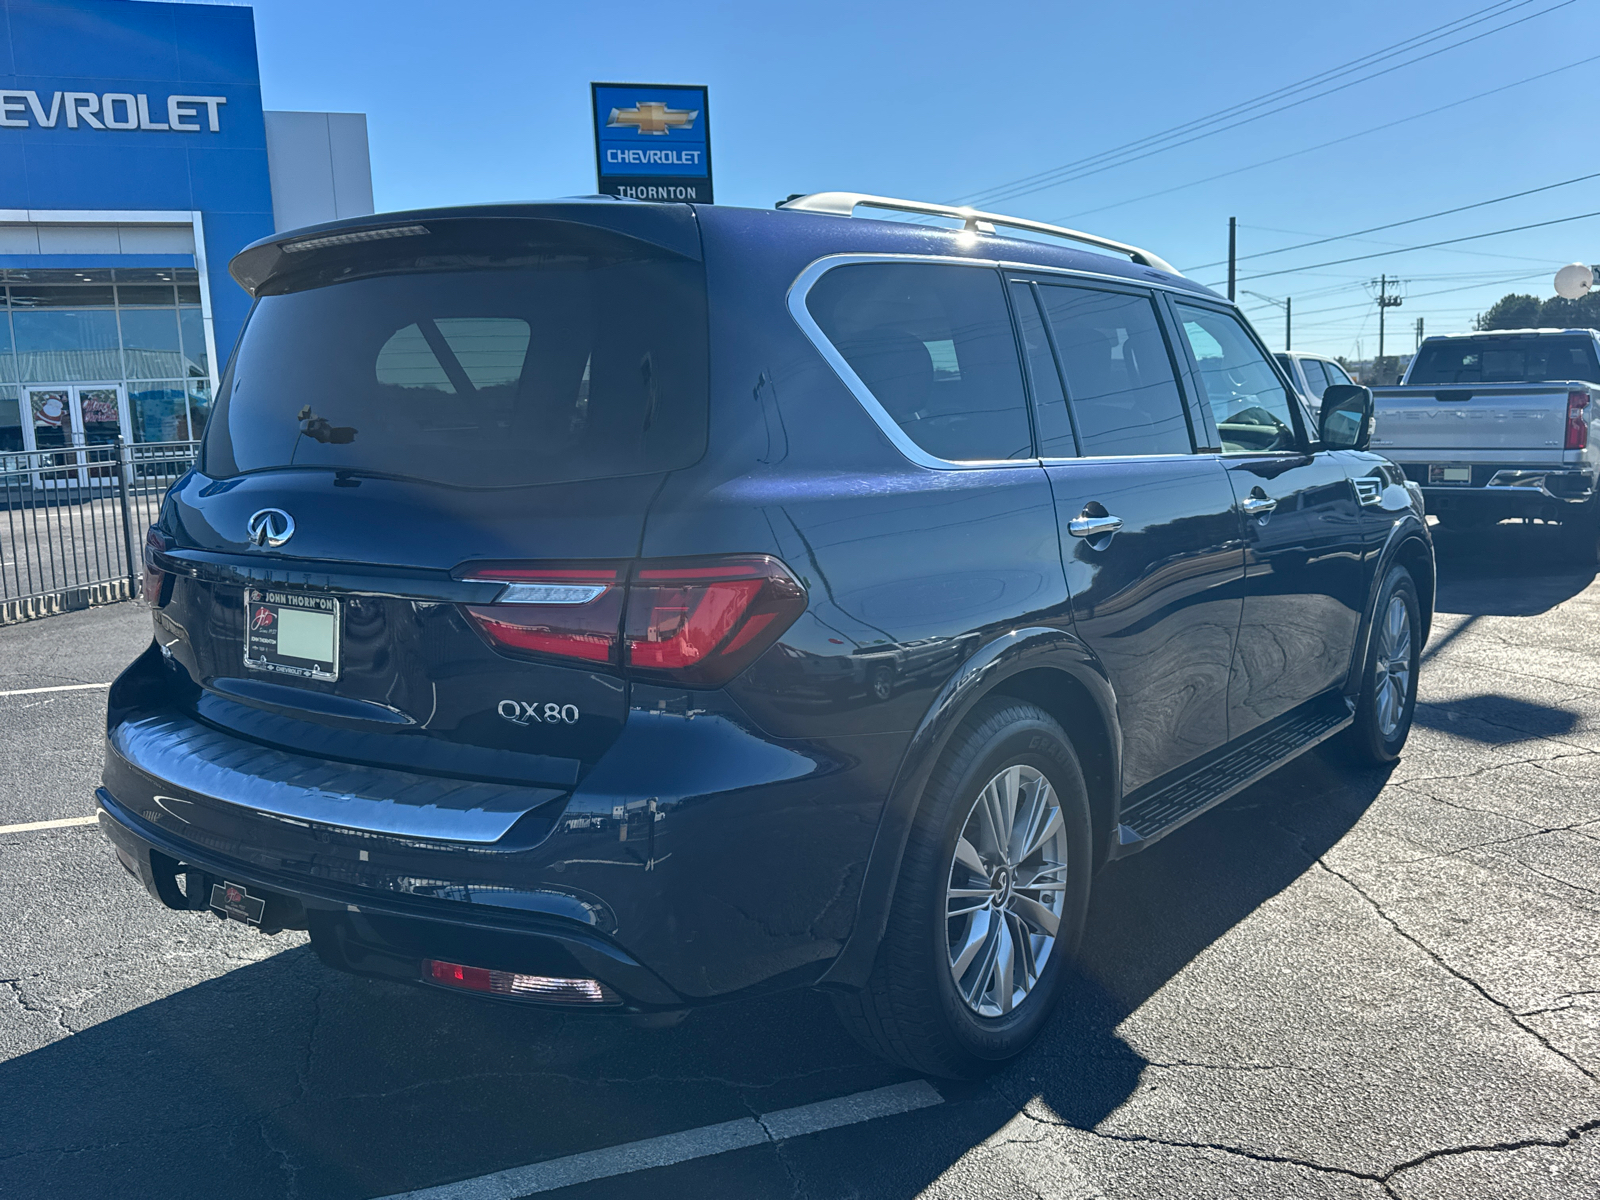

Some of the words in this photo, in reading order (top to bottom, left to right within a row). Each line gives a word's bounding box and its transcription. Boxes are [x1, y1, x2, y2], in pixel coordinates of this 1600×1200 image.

[0, 90, 227, 132] EVROLET
[607, 149, 701, 164] CHEVROLET
[617, 186, 697, 199] THORNTON
[265, 592, 287, 604] JOHN
[276, 665, 302, 675] CHEVROLET
[497, 700, 580, 726] QX80
